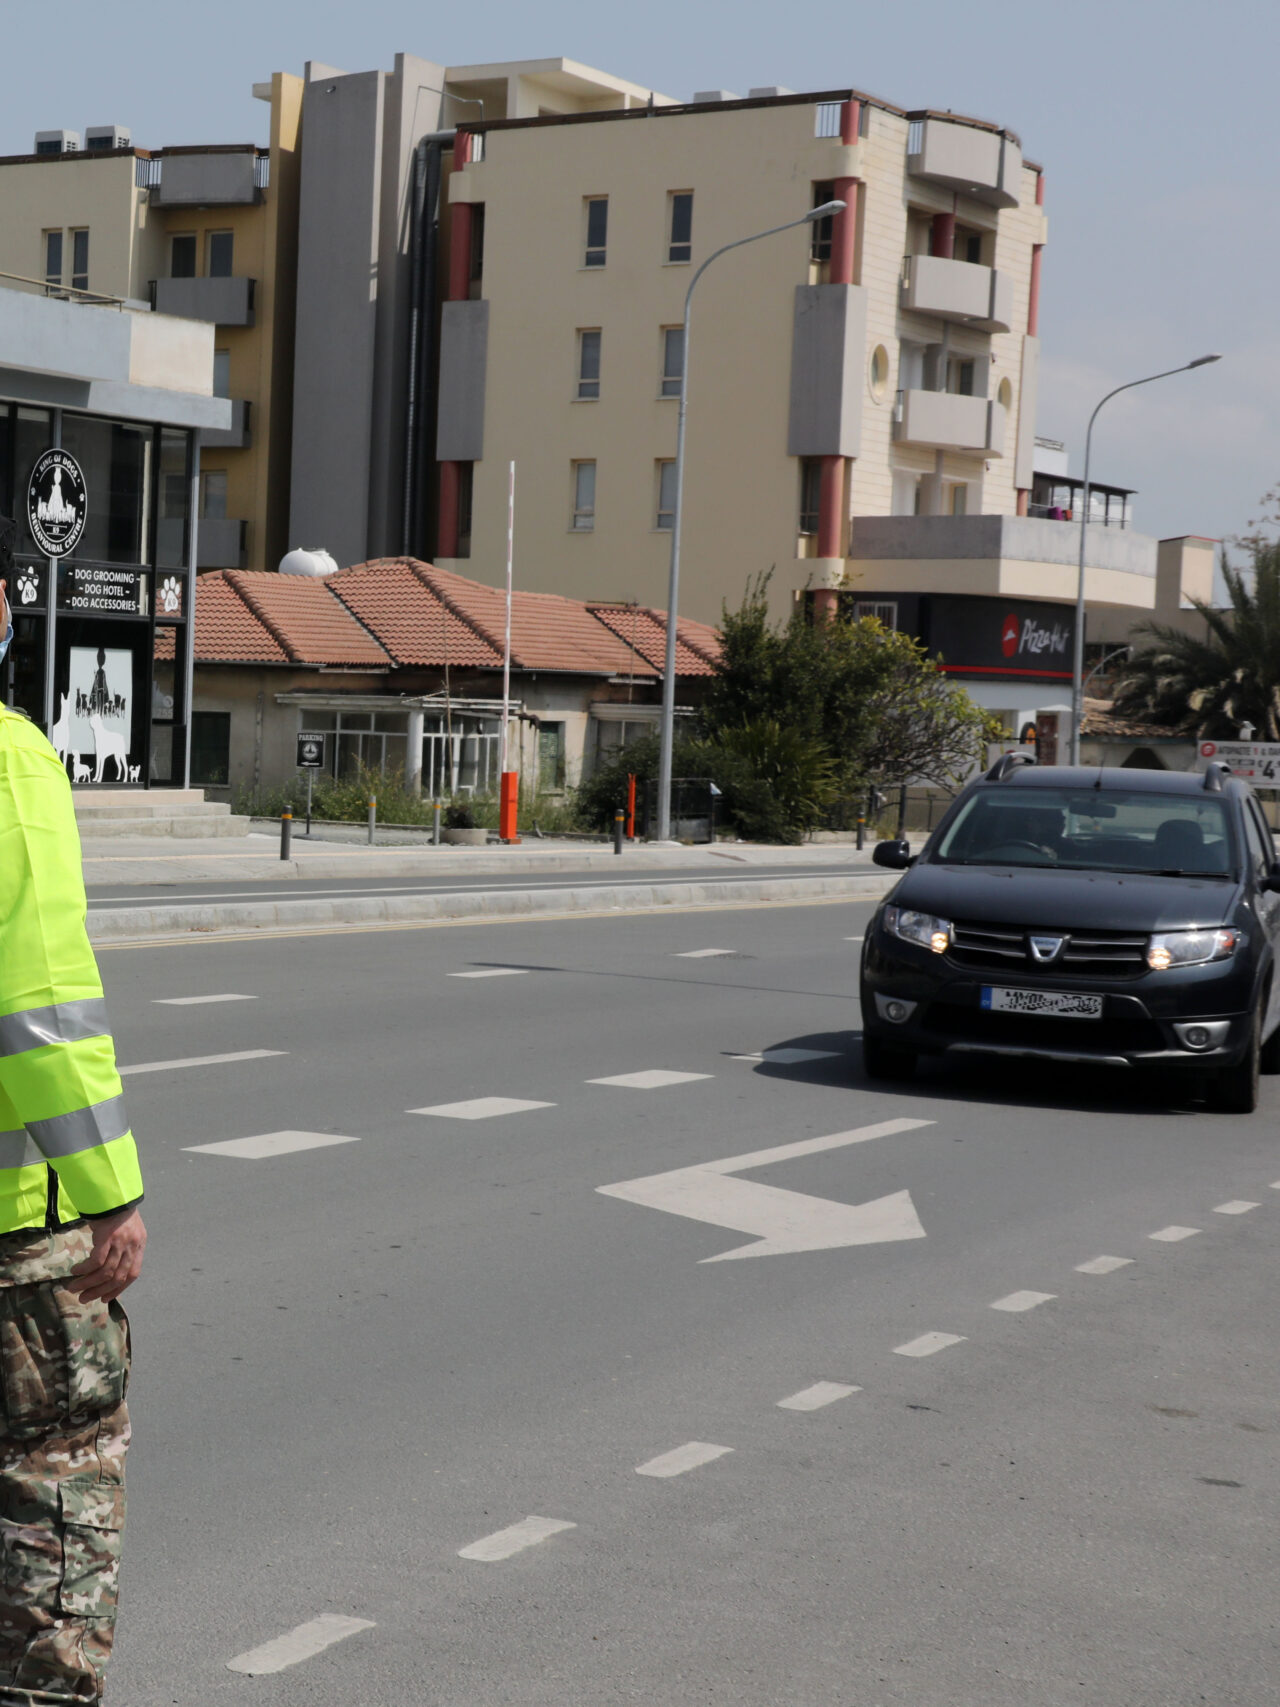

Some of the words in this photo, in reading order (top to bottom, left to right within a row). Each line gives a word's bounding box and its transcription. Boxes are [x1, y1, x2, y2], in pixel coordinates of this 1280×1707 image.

[39, 455, 53, 472] KING
[53, 454, 62, 463] OF
[62, 456, 78, 478] DOGS
[30, 512, 64, 553] BEHAVIOURAL
[64, 516, 83, 549] CENTRE
[74, 568, 92, 580] DOG
[93, 570, 135, 584] GROOMING
[24, 589, 35, 599] K9
[84, 583, 102, 595] DOG
[103, 584, 124, 597] HOTEL
[71, 596, 89, 607] DOG
[90, 597, 136, 611] ACCESSORIES
[1018, 618, 1051, 654] Pizza
[1049, 622, 1071, 654] Hut
[1263, 760, 1275, 780] 4
